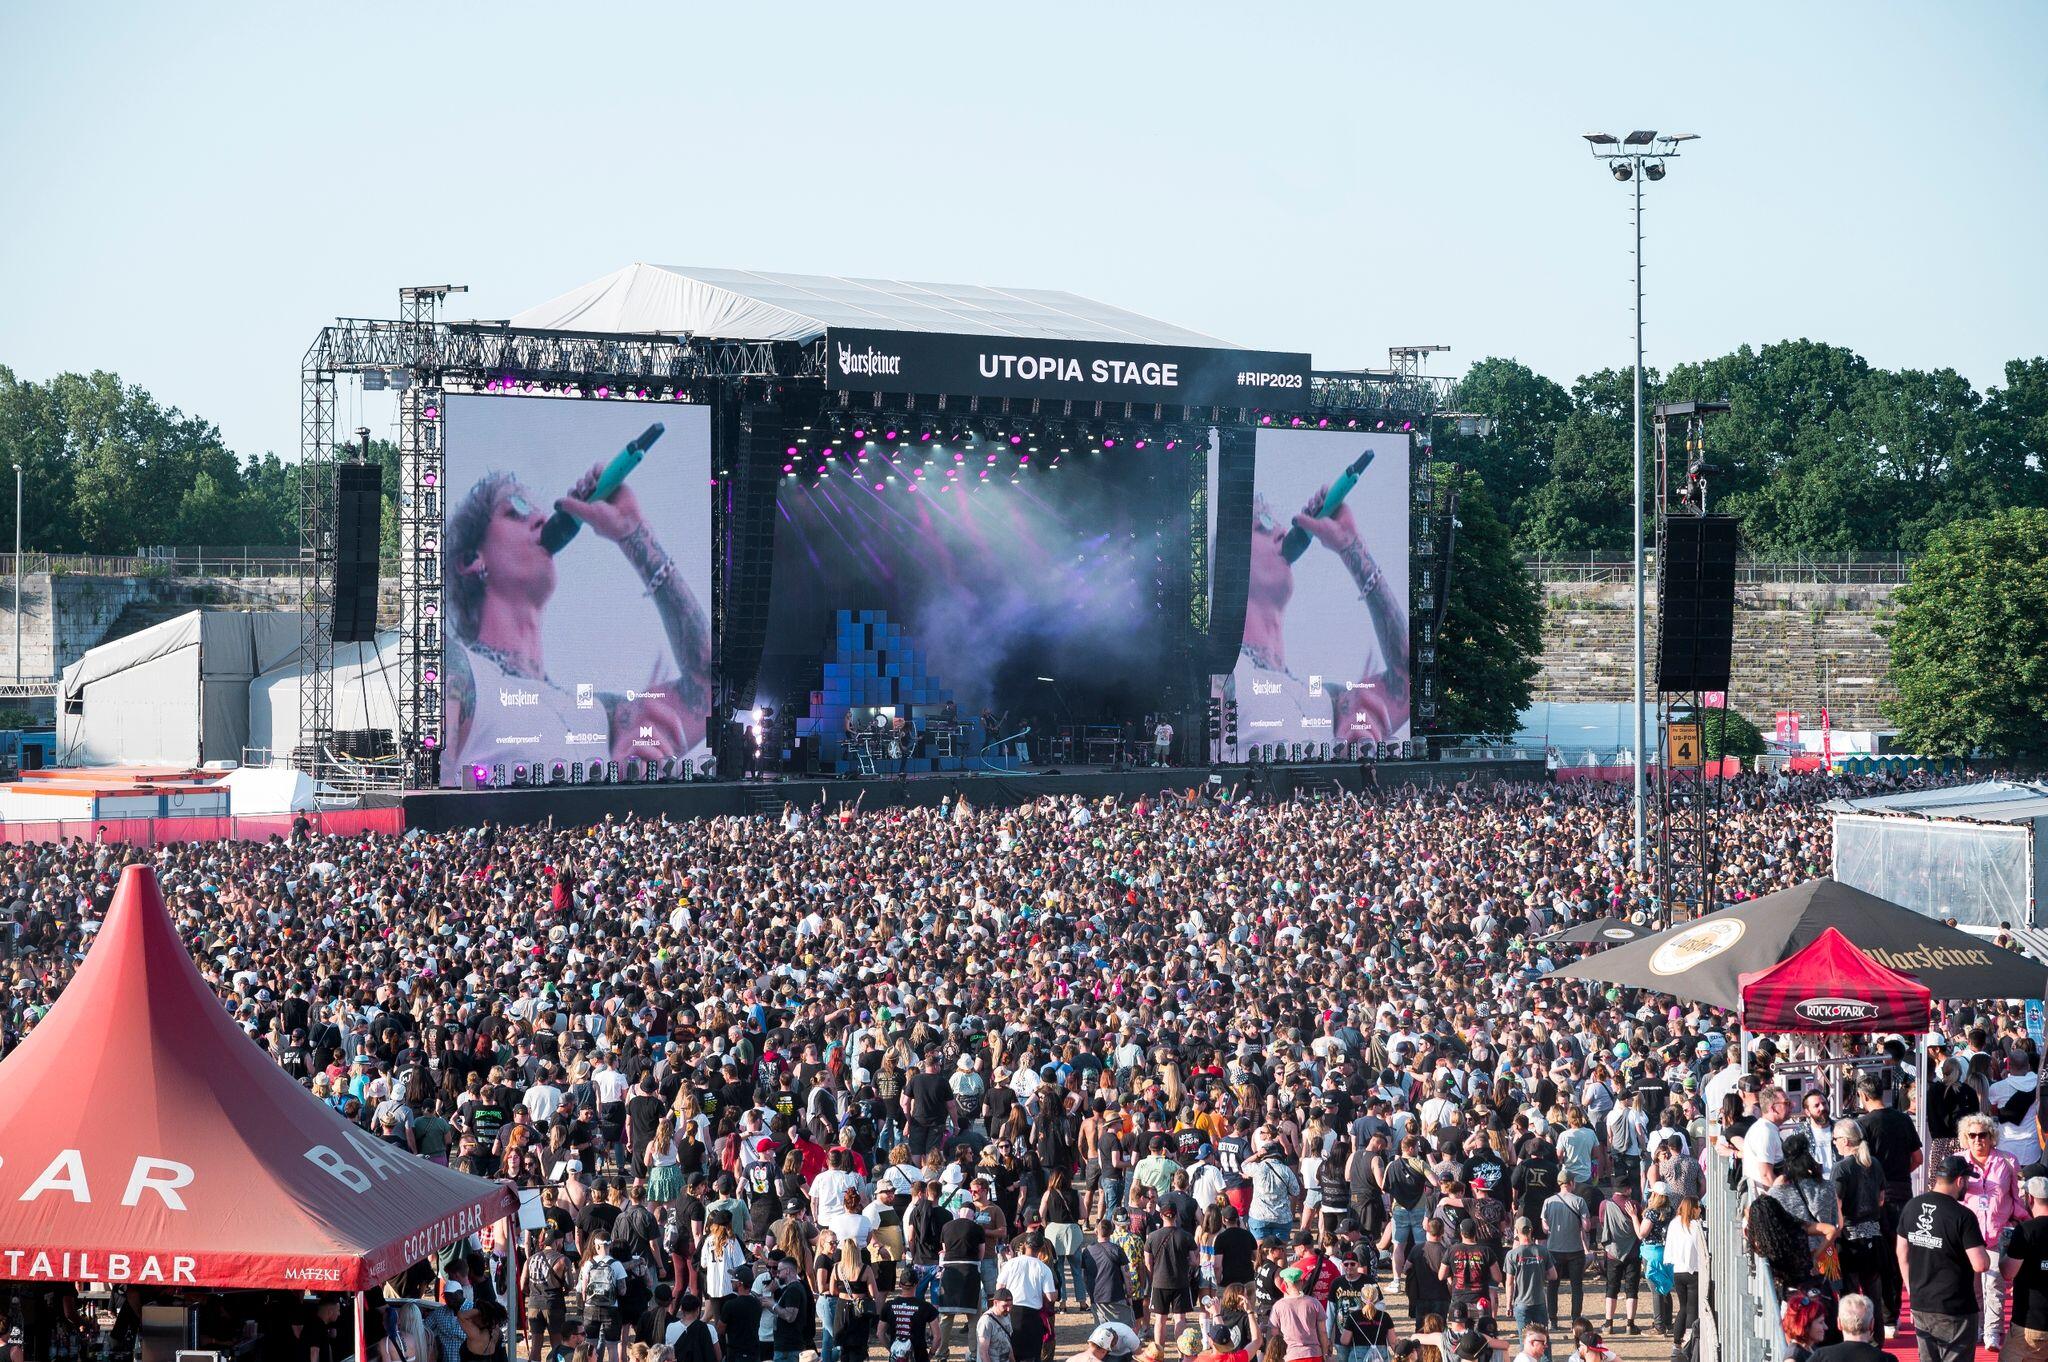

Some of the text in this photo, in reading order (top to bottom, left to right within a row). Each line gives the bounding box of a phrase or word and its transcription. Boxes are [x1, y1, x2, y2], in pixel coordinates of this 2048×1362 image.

[979, 354, 1179, 386] UTOPIA STAGE
[1237, 372, 1302, 388] #RIP2023
[1678, 743, 1692, 760] 4
[1806, 1005, 1865, 1017] ROCK PARK
[0, 1149, 195, 1211] AR
[404, 1203, 483, 1265] COCKTAILBAR
[4, 1250, 197, 1283] TAILBAR
[284, 1268, 340, 1281] MATZKE
